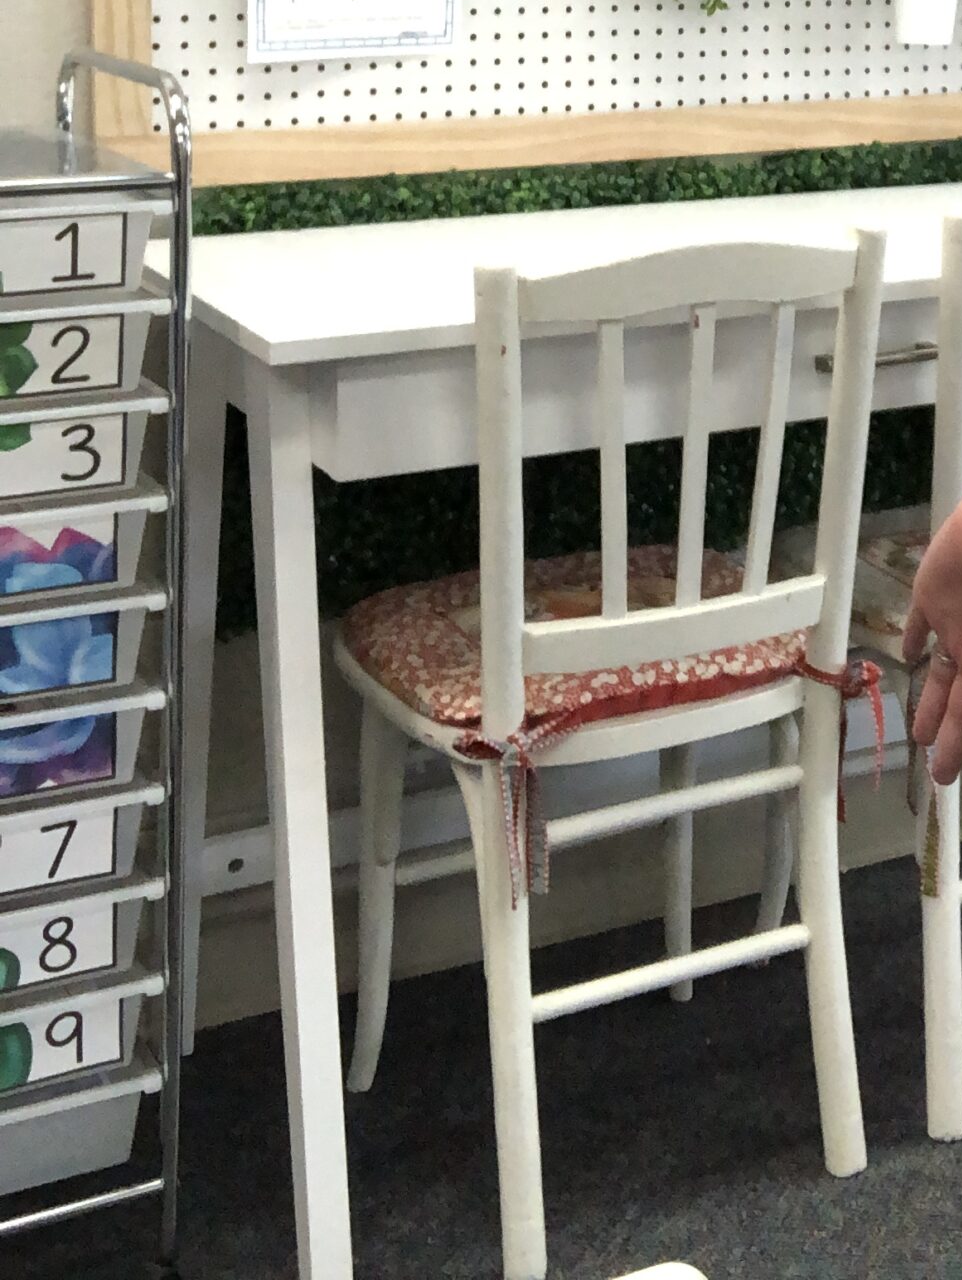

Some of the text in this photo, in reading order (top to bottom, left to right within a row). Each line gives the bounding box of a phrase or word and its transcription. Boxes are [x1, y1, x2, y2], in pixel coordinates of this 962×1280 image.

[51, 222, 96, 283] 1
[51, 325, 91, 384] 2
[61, 423, 102, 481] 3
[40, 819, 78, 879] 7
[39, 916, 78, 973] 8
[45, 1010, 84, 1064] 9
